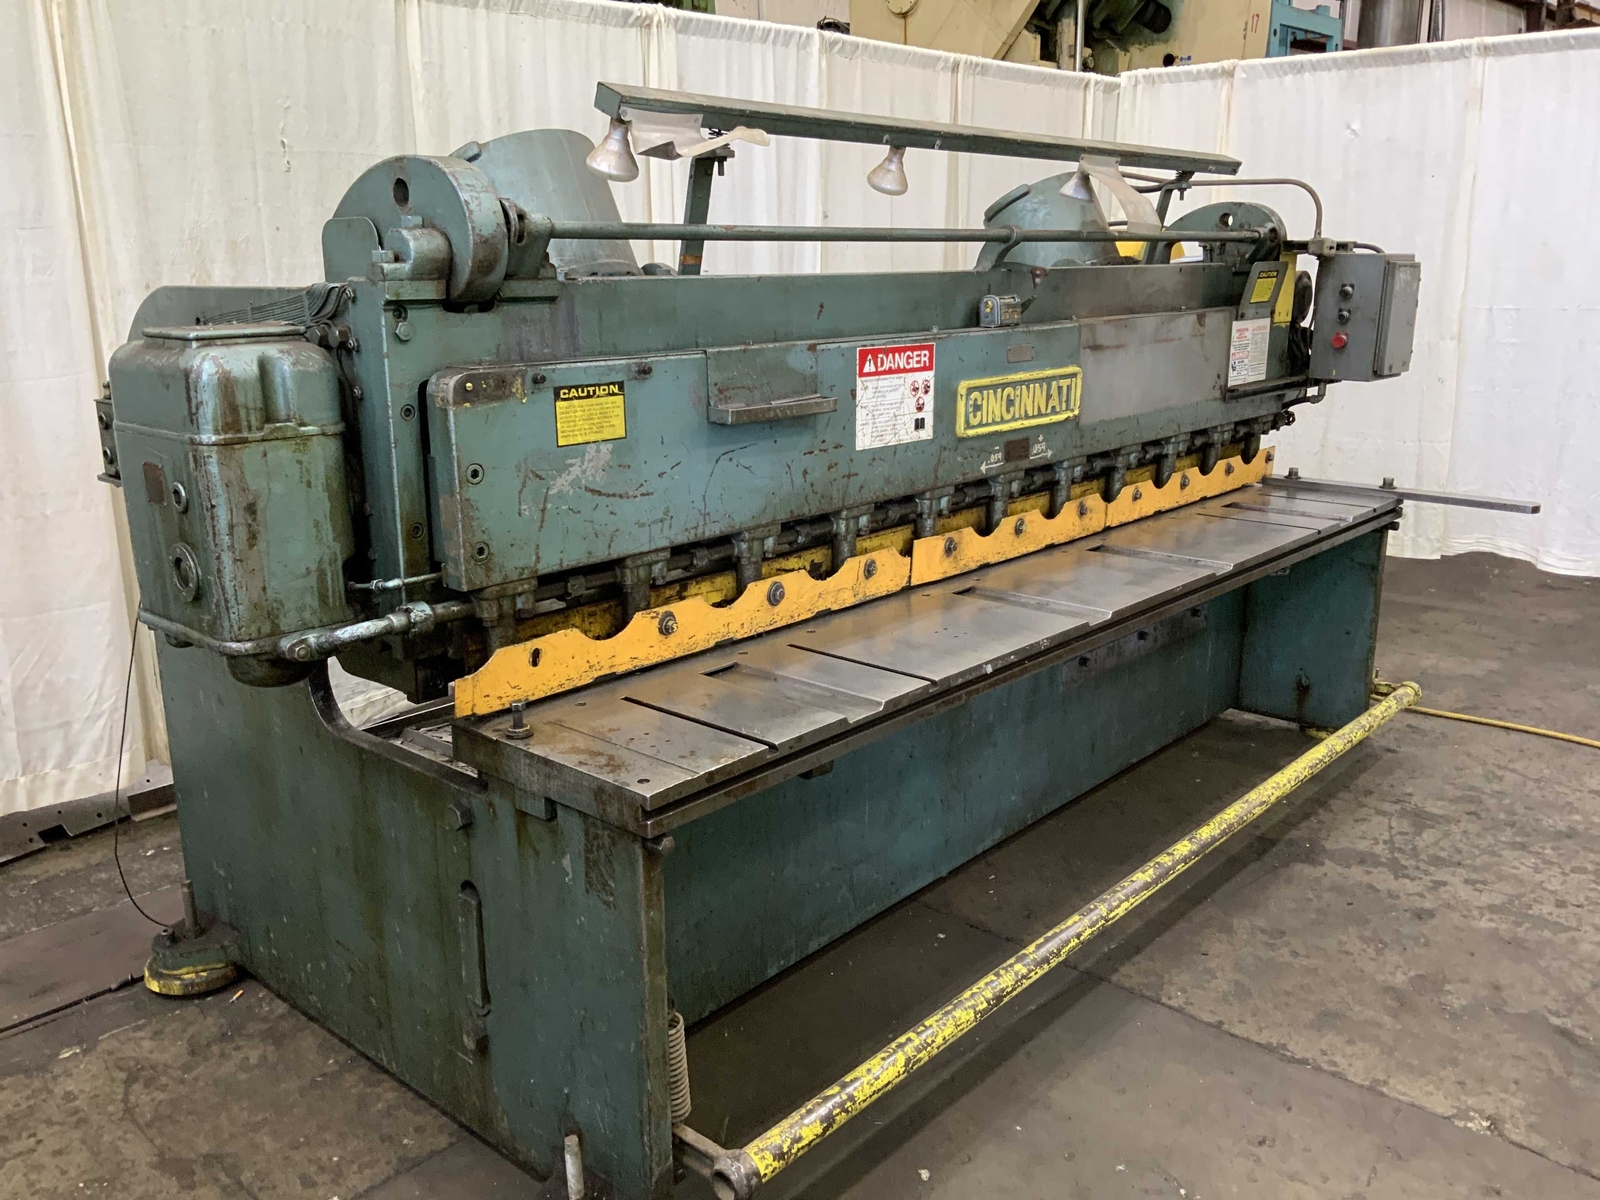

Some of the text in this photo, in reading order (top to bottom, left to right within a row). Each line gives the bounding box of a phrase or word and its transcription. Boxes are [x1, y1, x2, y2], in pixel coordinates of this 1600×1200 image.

[1251, 13, 1261, 33] 17
[877, 350, 930, 372] DANGER
[559, 385, 619, 399] CAUTION
[969, 378, 1077, 426] CINCINNATI
